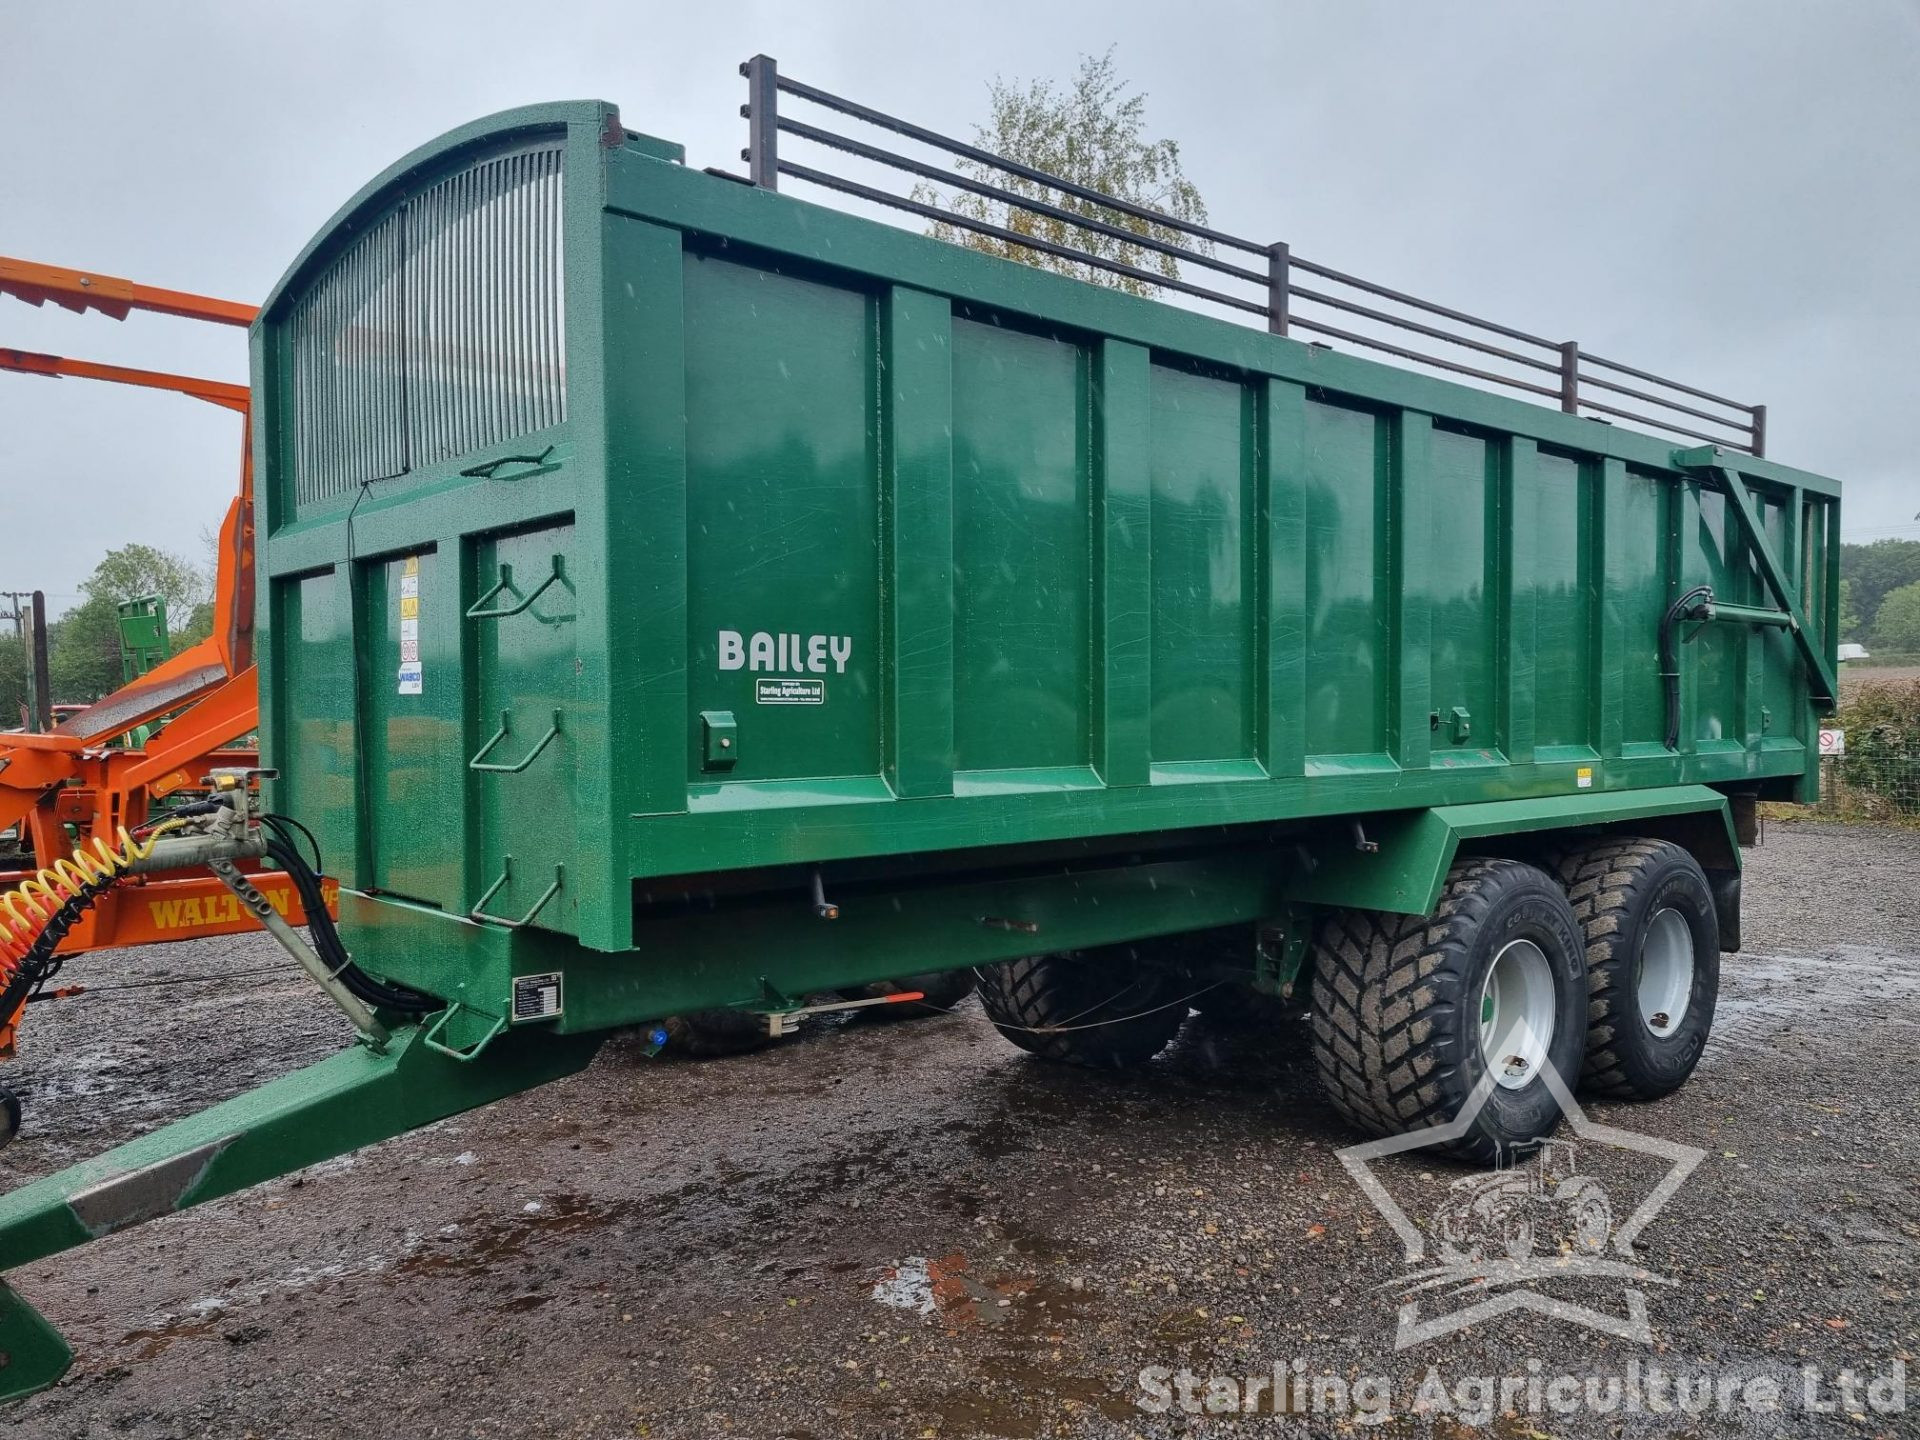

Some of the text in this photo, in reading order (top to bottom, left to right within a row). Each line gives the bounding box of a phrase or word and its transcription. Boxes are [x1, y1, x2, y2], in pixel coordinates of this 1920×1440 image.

[718, 630, 852, 673] BAILEY
[760, 686, 820, 697] Starling Agriculture Ltd
